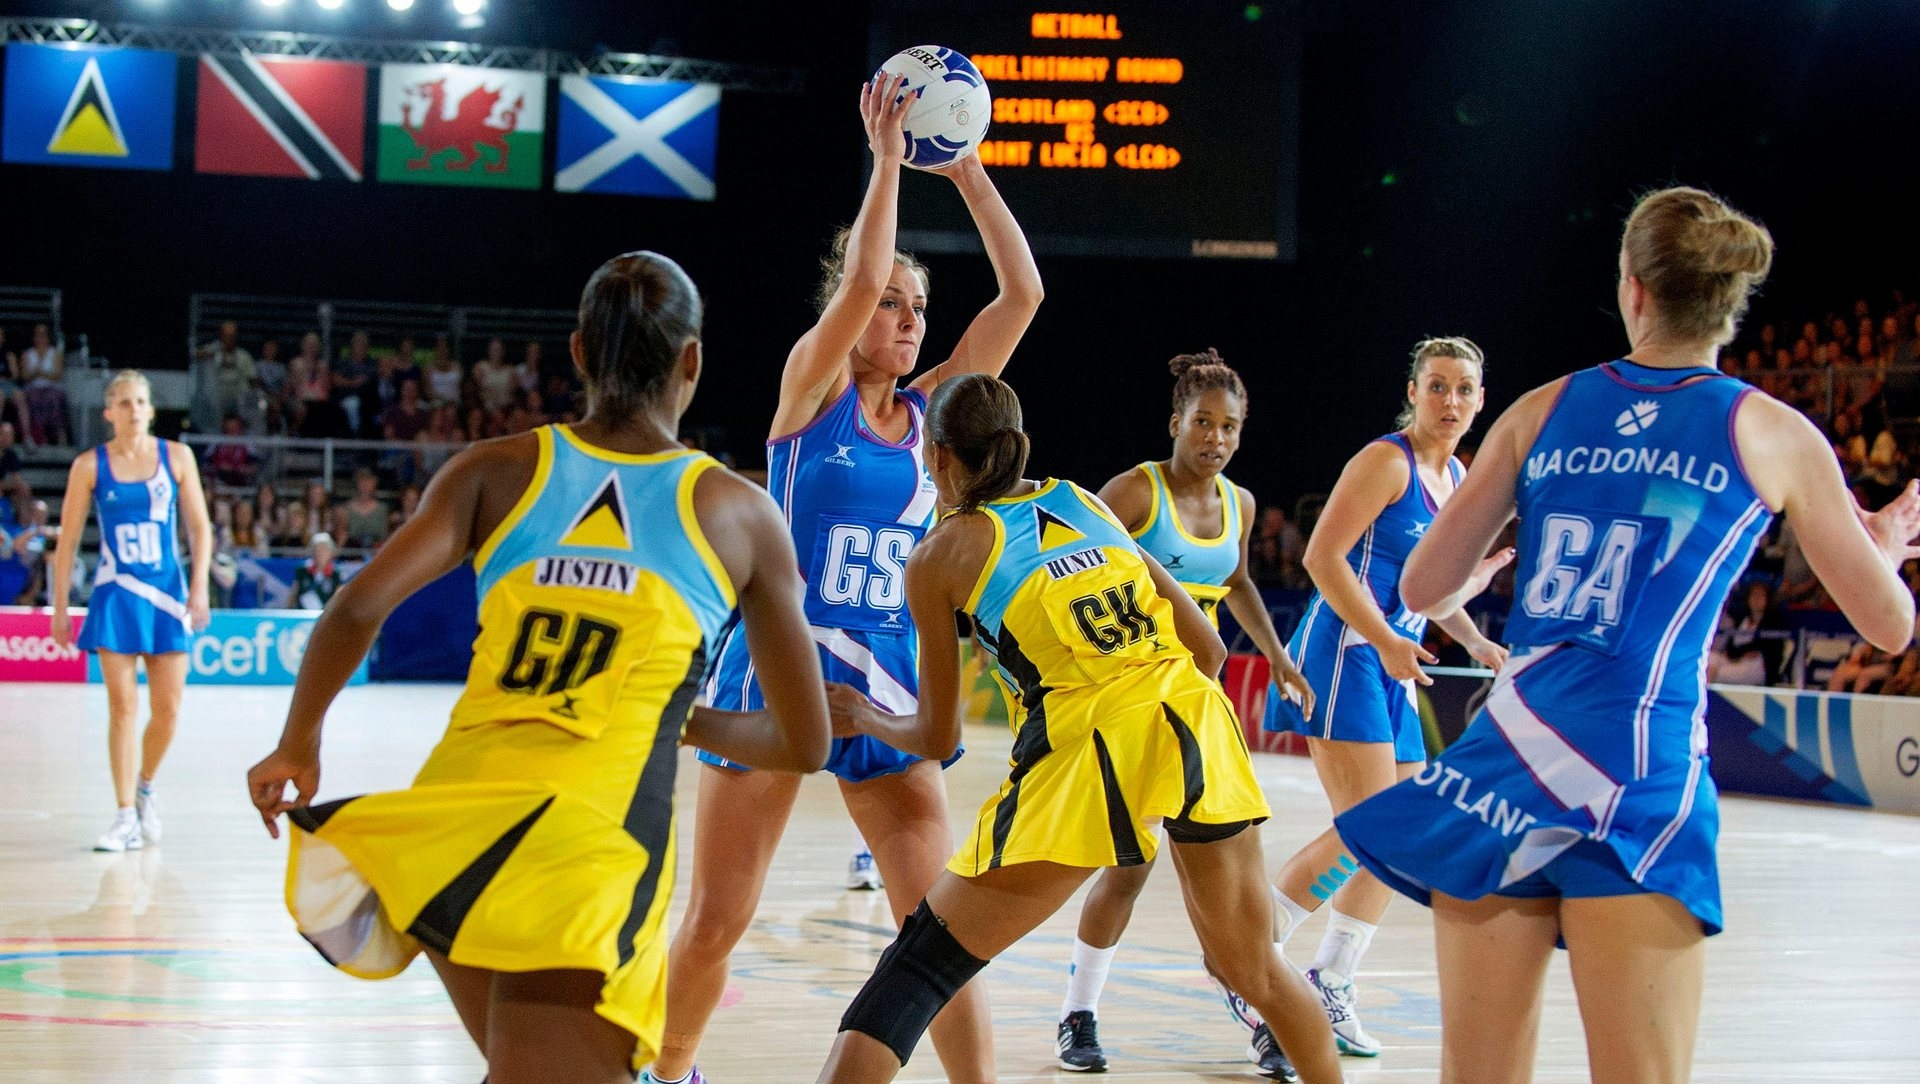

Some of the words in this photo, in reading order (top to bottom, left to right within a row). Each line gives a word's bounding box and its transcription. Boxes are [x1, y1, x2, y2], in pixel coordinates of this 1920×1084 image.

[1032, 13, 1121, 39] NETBALL
[1117, 58, 1183, 82] ROUND
[993, 98, 1095, 123] SCOTLAND
[1040, 142, 1106, 167] LUCIA
[824, 456, 856, 468] GILBERT
[1525, 446, 1730, 494] MACDONALD
[115, 522, 162, 565] GD
[538, 557, 634, 593] JUSTIN
[819, 523, 915, 610] GS
[1521, 513, 1643, 626] GA
[1069, 580, 1158, 655] GK
